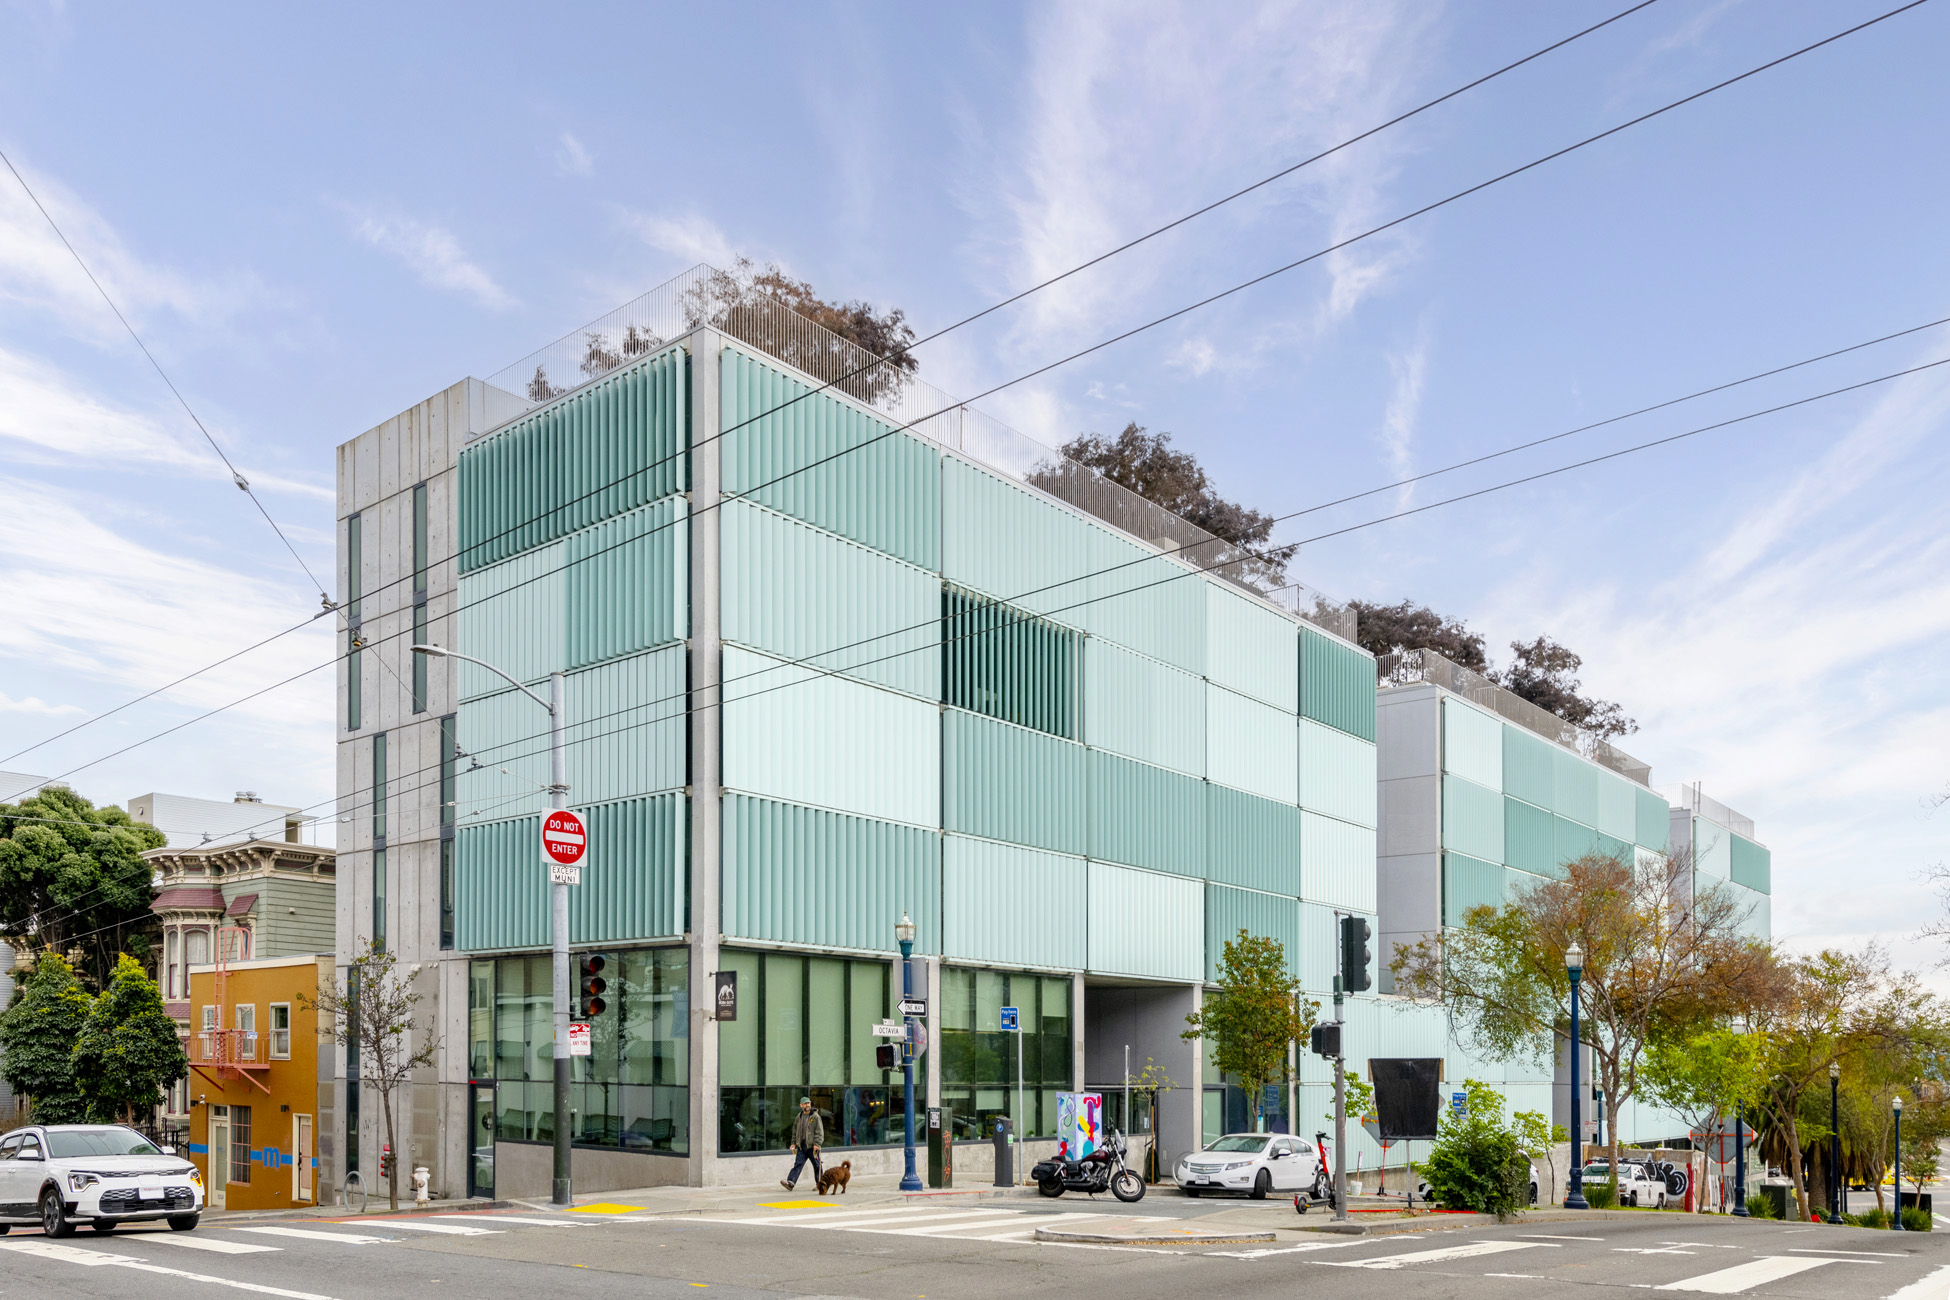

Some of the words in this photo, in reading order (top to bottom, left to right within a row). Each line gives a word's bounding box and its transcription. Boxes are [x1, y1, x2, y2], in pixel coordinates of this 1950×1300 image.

[550, 819, 561, 829] DO
[563, 821, 579, 832] NOT
[552, 843, 578, 855] ENTER
[552, 866, 577, 875] EXCEPT
[554, 874, 576, 882] MUNI
[878, 1026, 900, 1035] OCTAVIA
